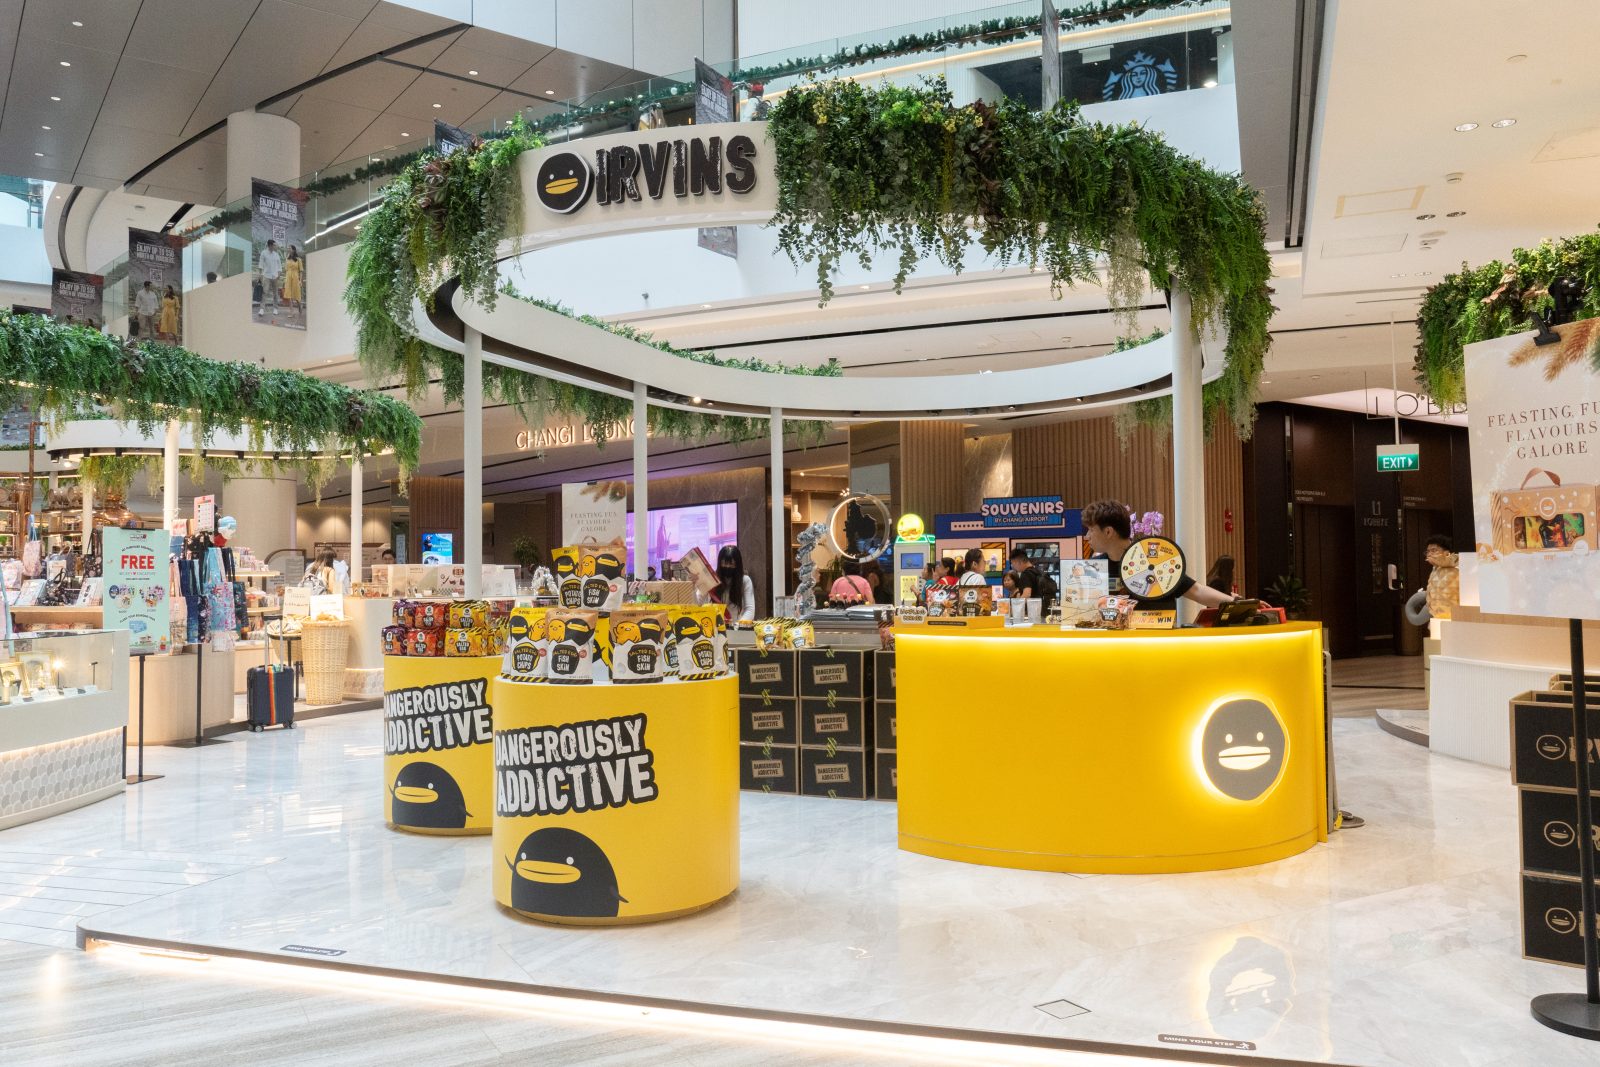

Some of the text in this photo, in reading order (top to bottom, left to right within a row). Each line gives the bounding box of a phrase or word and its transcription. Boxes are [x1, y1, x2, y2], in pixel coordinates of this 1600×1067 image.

[596, 135, 757, 206] IRVINS
[1488, 405, 1575, 428] FEASTING,
[516, 425, 576, 449] CHANGI
[1506, 420, 1598, 443] FLAVOURS
[1517, 441, 1588, 459] GALORE
[1383, 457, 1406, 469] EXIT
[981, 501, 1065, 517] SOUVENIRS
[121, 555, 154, 570] FREE
[516, 662, 532, 670] CHIPS
[556, 664, 570, 672] SKIN
[636, 663, 650, 671] SKIN
[496, 718, 642, 766] DANGEROUSLY
[498, 754, 654, 812] ADDICTIVE
